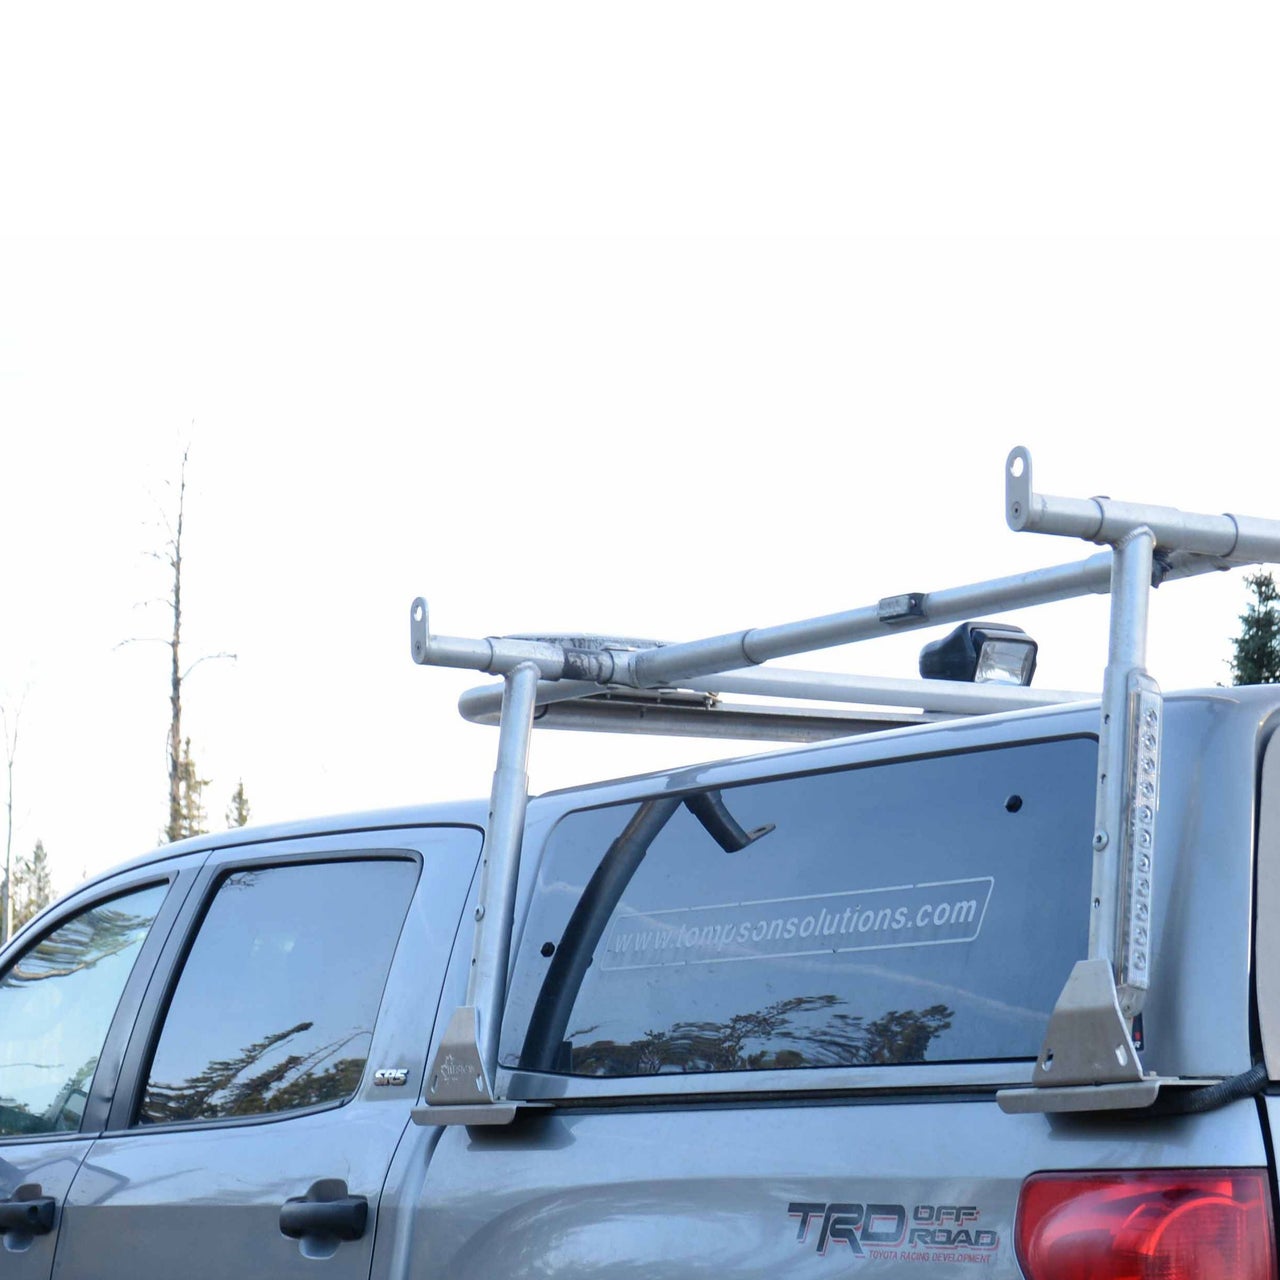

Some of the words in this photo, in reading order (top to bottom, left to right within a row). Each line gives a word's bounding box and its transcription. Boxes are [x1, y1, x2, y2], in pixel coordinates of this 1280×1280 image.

[374, 1068, 410, 1086] SR5
[912, 1204, 979, 1226] OFF
[787, 1202, 907, 1257] TRD
[908, 1228, 999, 1251] ROAD
[868, 1249, 898, 1260] TOYOTA
[900, 1250, 930, 1262] RACING
[931, 1252, 992, 1263] DEVELOPMENT
